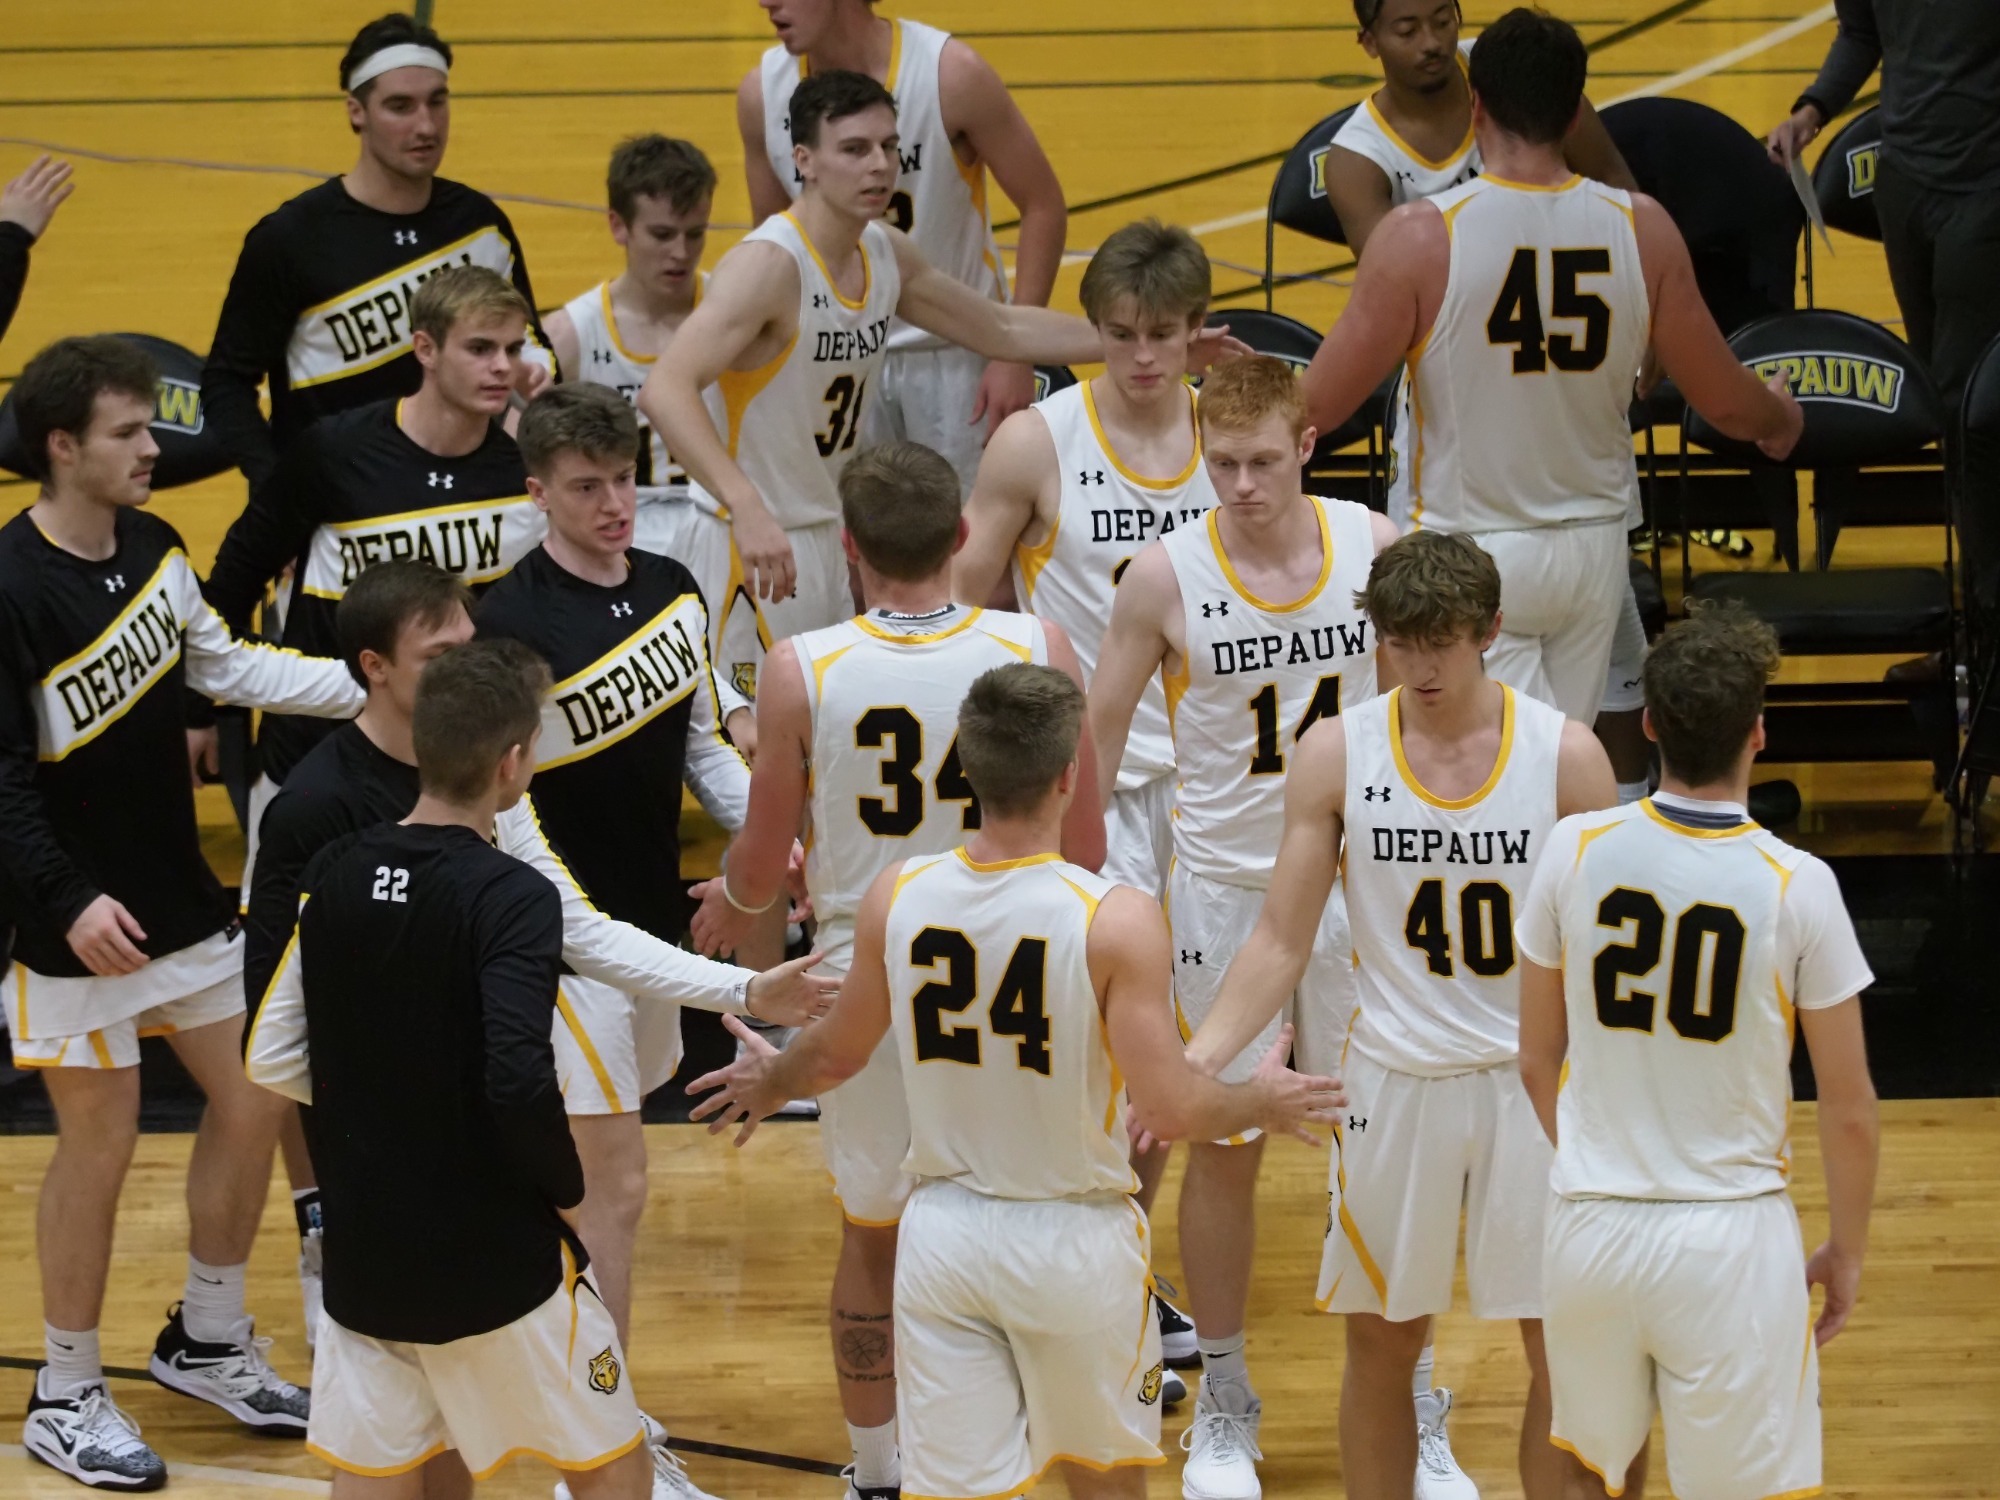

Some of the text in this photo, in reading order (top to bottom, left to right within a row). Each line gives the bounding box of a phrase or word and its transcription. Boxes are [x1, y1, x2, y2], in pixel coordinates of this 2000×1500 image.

[1486, 246, 1612, 376] 45
[813, 372, 868, 458] 31
[1753, 356, 1898, 407] EPAUW
[339, 513, 503, 586] DEPAUW
[1091, 508, 1210, 542] DEPA
[56, 588, 181, 732] DEPAUW
[555, 619, 698, 746] DEPAUW
[1212, 620, 1366, 675] DEPAUW
[854, 704, 982, 838] 34
[1248, 673, 1342, 776] 14
[372, 865, 410, 903] 22
[1372, 827, 1530, 865] DEPAUW
[1403, 876, 1518, 979] 40
[1592, 884, 1748, 1046] 20
[909, 925, 1053, 1078] 24
